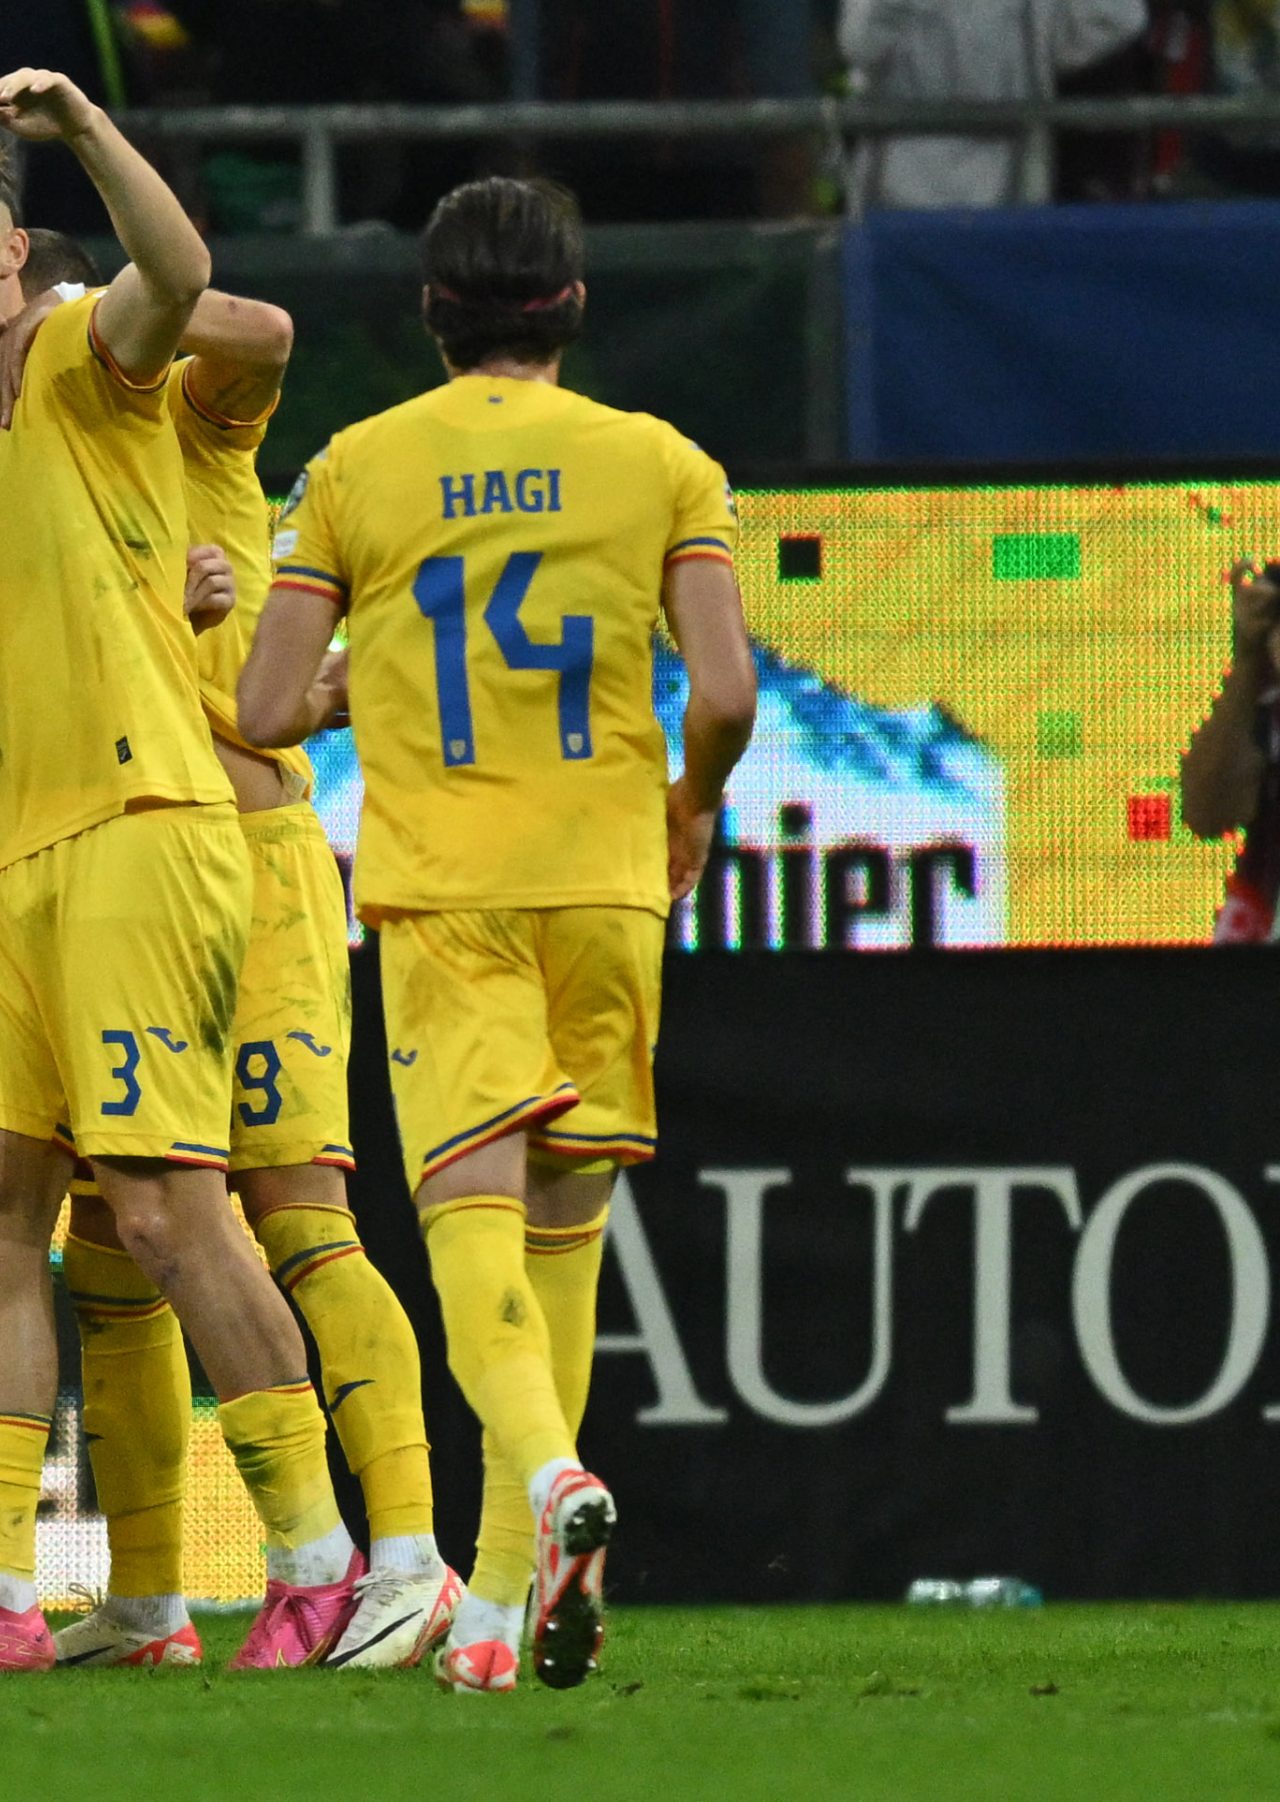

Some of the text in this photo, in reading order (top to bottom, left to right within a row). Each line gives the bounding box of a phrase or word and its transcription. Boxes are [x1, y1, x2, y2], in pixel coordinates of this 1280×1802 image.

[440, 468, 561, 519] HAGI
[412, 551, 594, 767] 14
[100, 1030, 142, 1116] 3
[232, 1040, 282, 1127] 9
[594, 1162, 1280, 1427] AUTO
